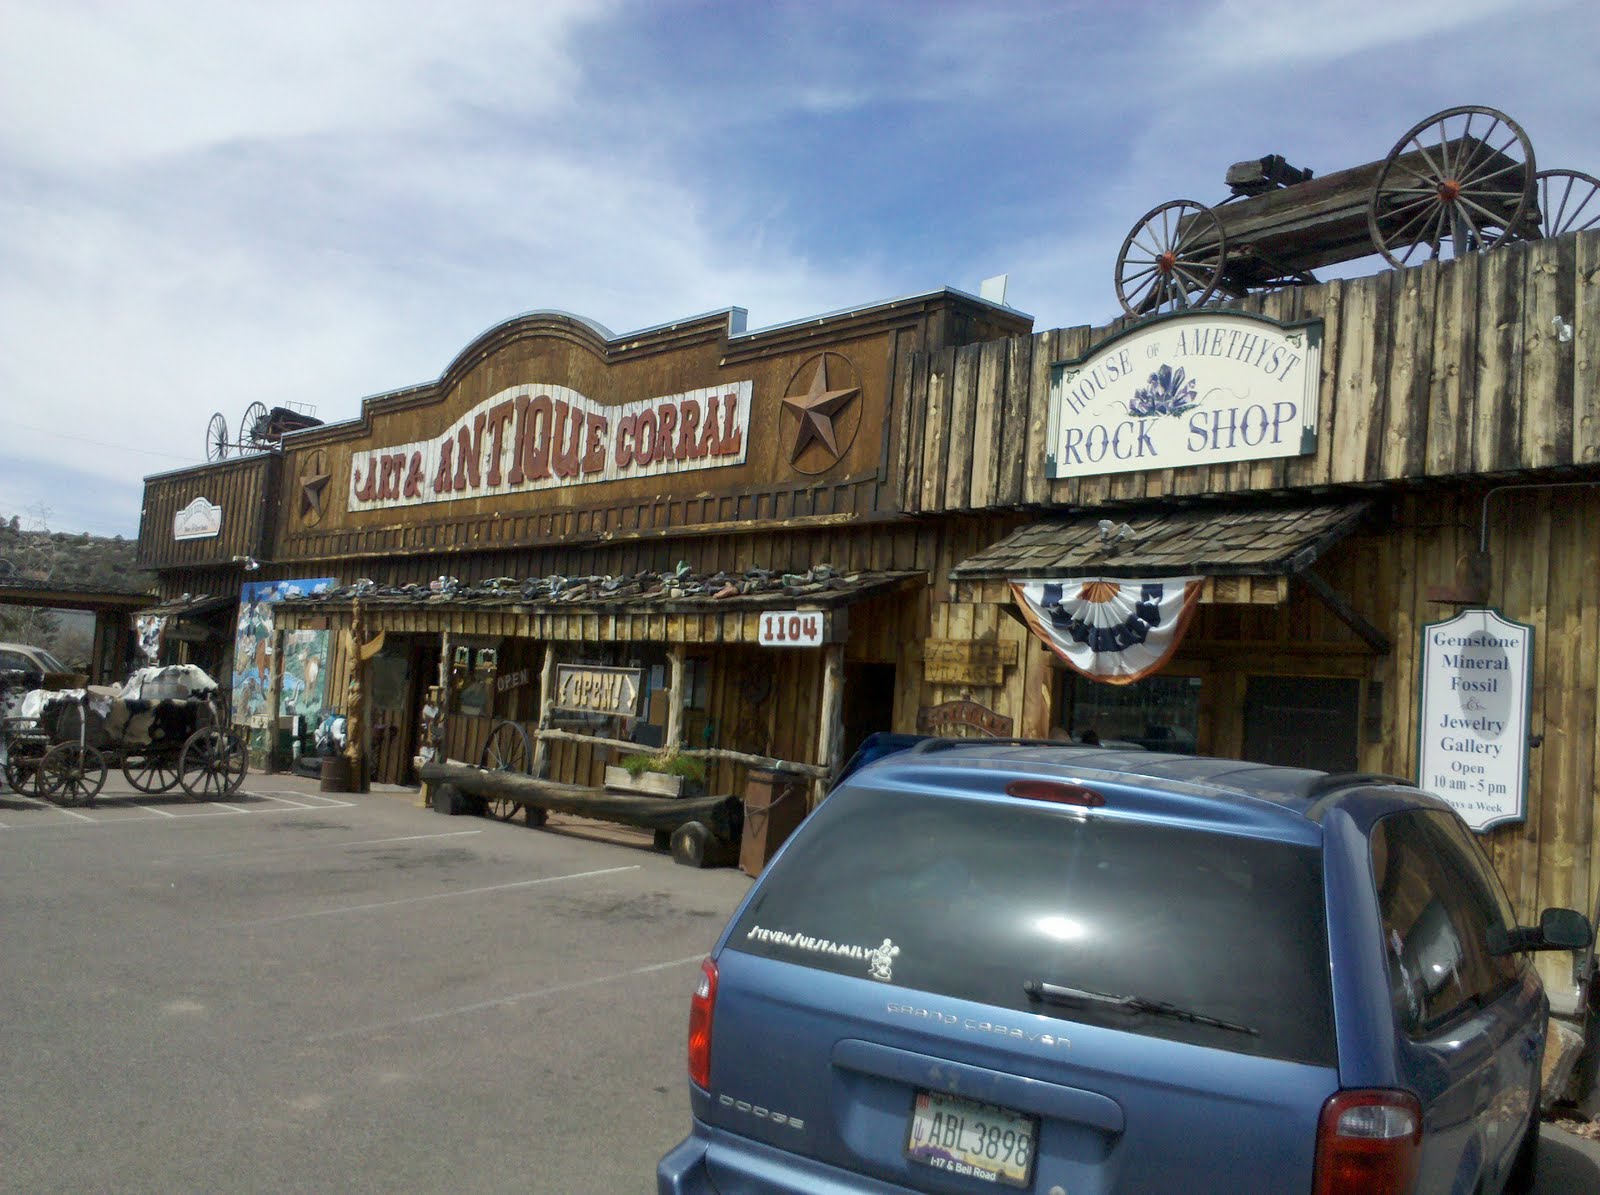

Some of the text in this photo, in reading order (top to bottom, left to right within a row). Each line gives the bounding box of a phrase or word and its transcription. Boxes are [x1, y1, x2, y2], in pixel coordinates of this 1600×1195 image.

[1066, 328, 1301, 415] HOUSE OF AMETHYST
[1063, 401, 1297, 465] ROCK SHOP
[354, 393, 741, 501] ART & ANTIQUE CORRAL
[763, 615, 818, 641] 1104
[1433, 632, 1520, 649] Gemstone
[1442, 654, 1508, 670] Mineral
[496, 669, 530, 693] OPEN
[572, 671, 623, 710] OPEN!
[1451, 677, 1497, 692] Fossil
[1440, 714, 1505, 735] Jewelry
[1440, 737, 1502, 758] Gallery
[1451, 760, 1485, 775] Open
[1434, 775, 1446, 789] 10
[1449, 778, 1466, 790] am
[1477, 779, 1485, 792] 5
[1488, 782, 1507, 797] pm
[1475, 801, 1503, 813] Week
[887, 1002, 1072, 1049] GRAND CARAVAN
[719, 1093, 804, 1129] DODGE
[928, 1111, 1030, 1168] ABL3898
[946, 1160, 954, 1171] &
[955, 1162, 972, 1175] Bell
[973, 1167, 997, 1182] Road
